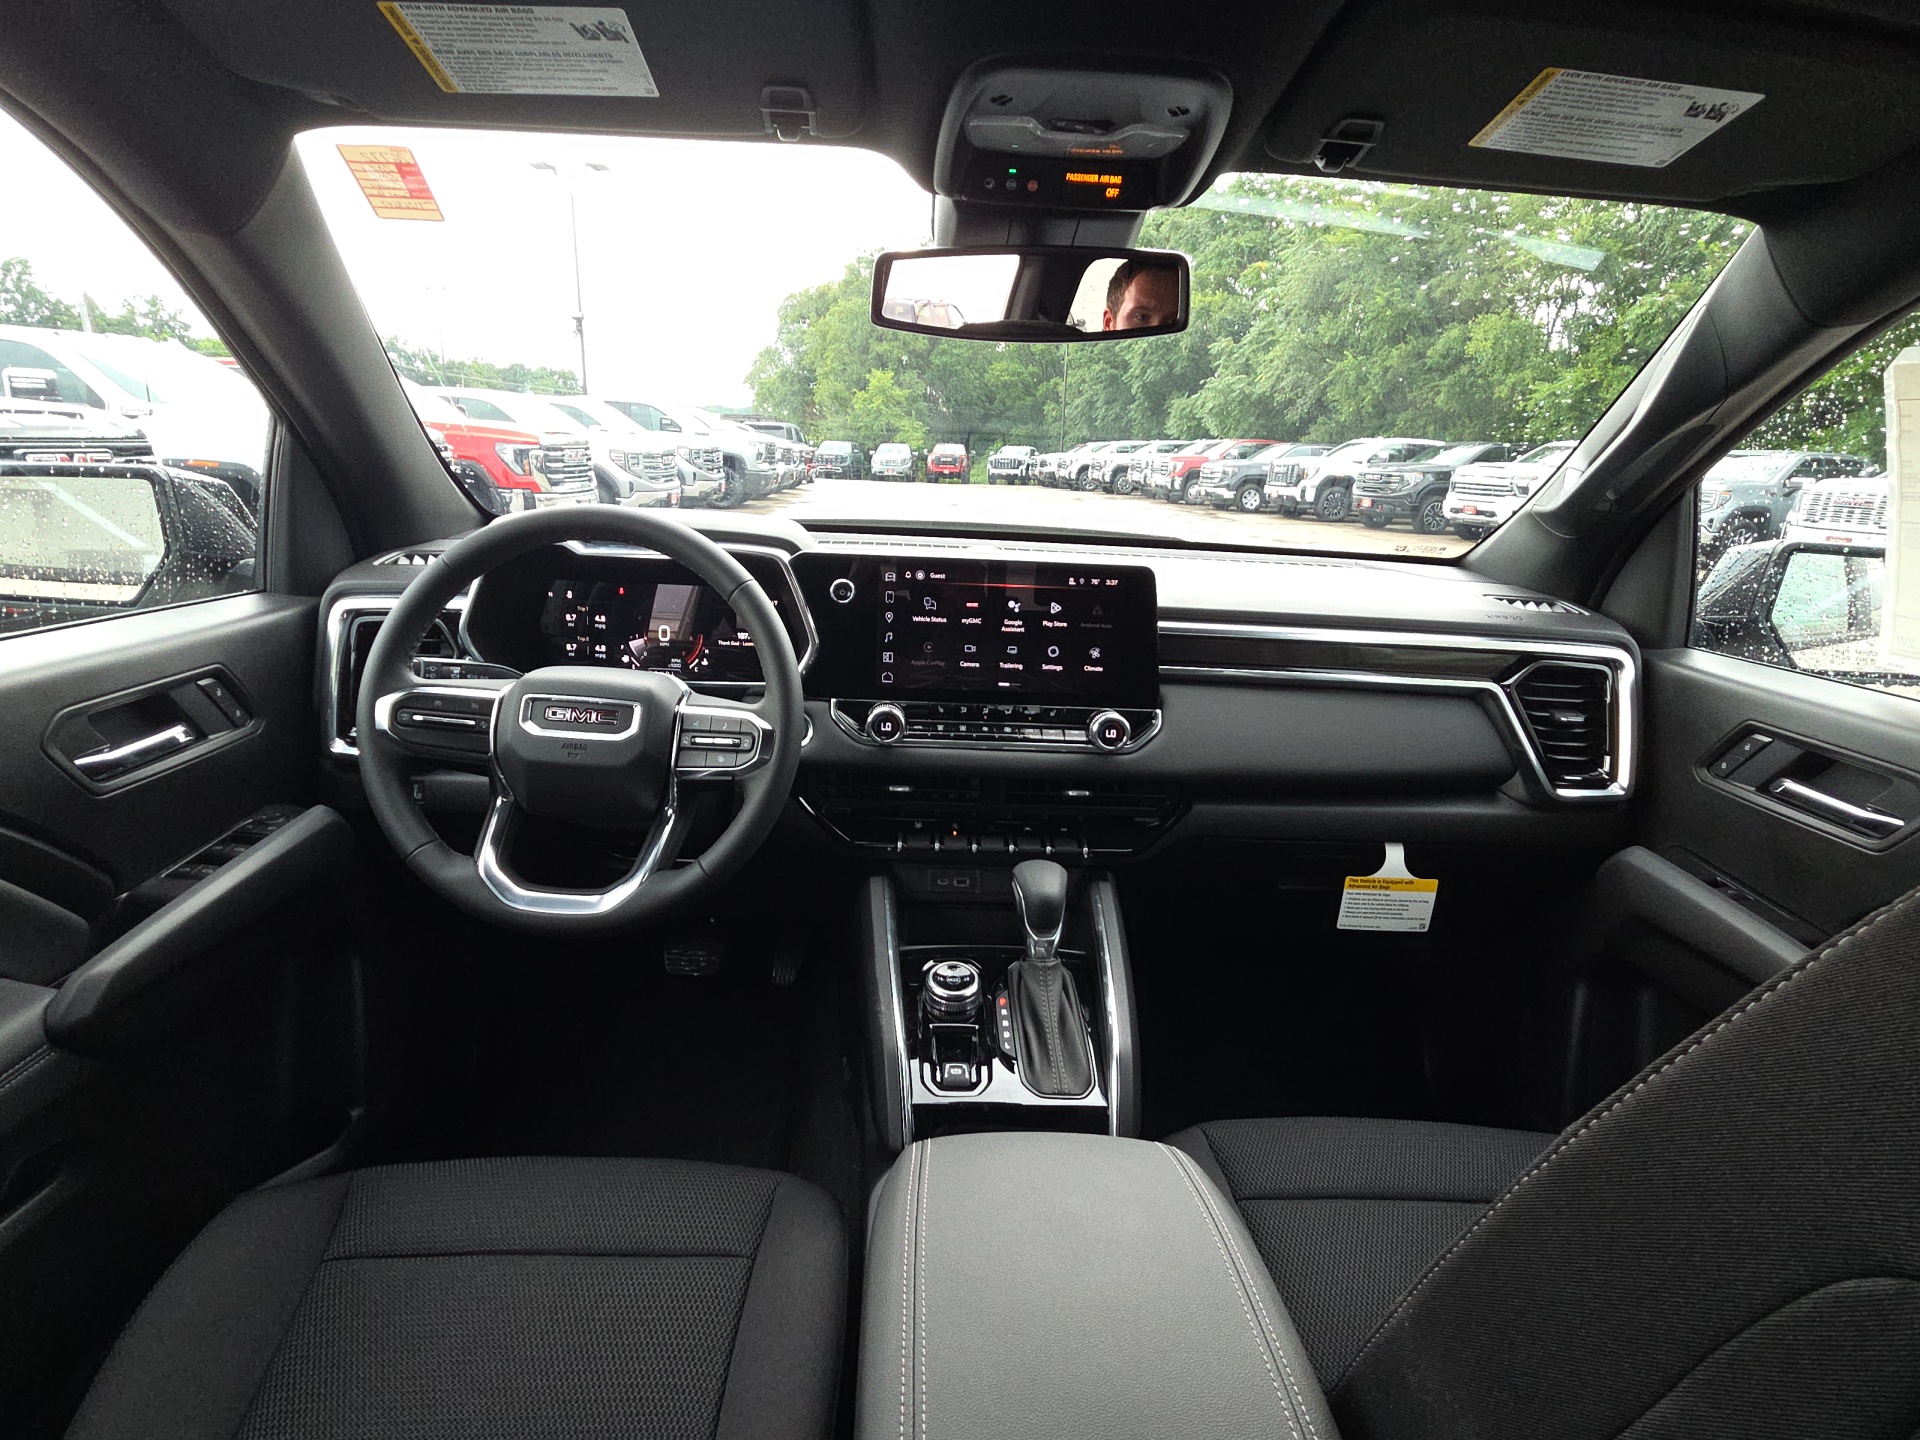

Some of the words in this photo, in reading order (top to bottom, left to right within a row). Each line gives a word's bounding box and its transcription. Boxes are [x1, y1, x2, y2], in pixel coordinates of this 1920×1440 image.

[447, 6, 493, 14] ADVANCED
[1602, 75, 1646, 87] ADVANCED
[1066, 172, 1099, 183] PASSENGER
[1100, 175, 1110, 183] AIR
[1110, 175, 1122, 184] BAG
[1105, 187, 1120, 198] OFF
[1004, 619, 1023, 627] Google
[658, 625, 671, 641] 0
[999, 662, 1023, 671] Trailering
[545, 706, 620, 726] GMC
[881, 722, 892, 731] LO
[1106, 729, 1117, 738] LO
[561, 742, 588, 751] AIRBAG
